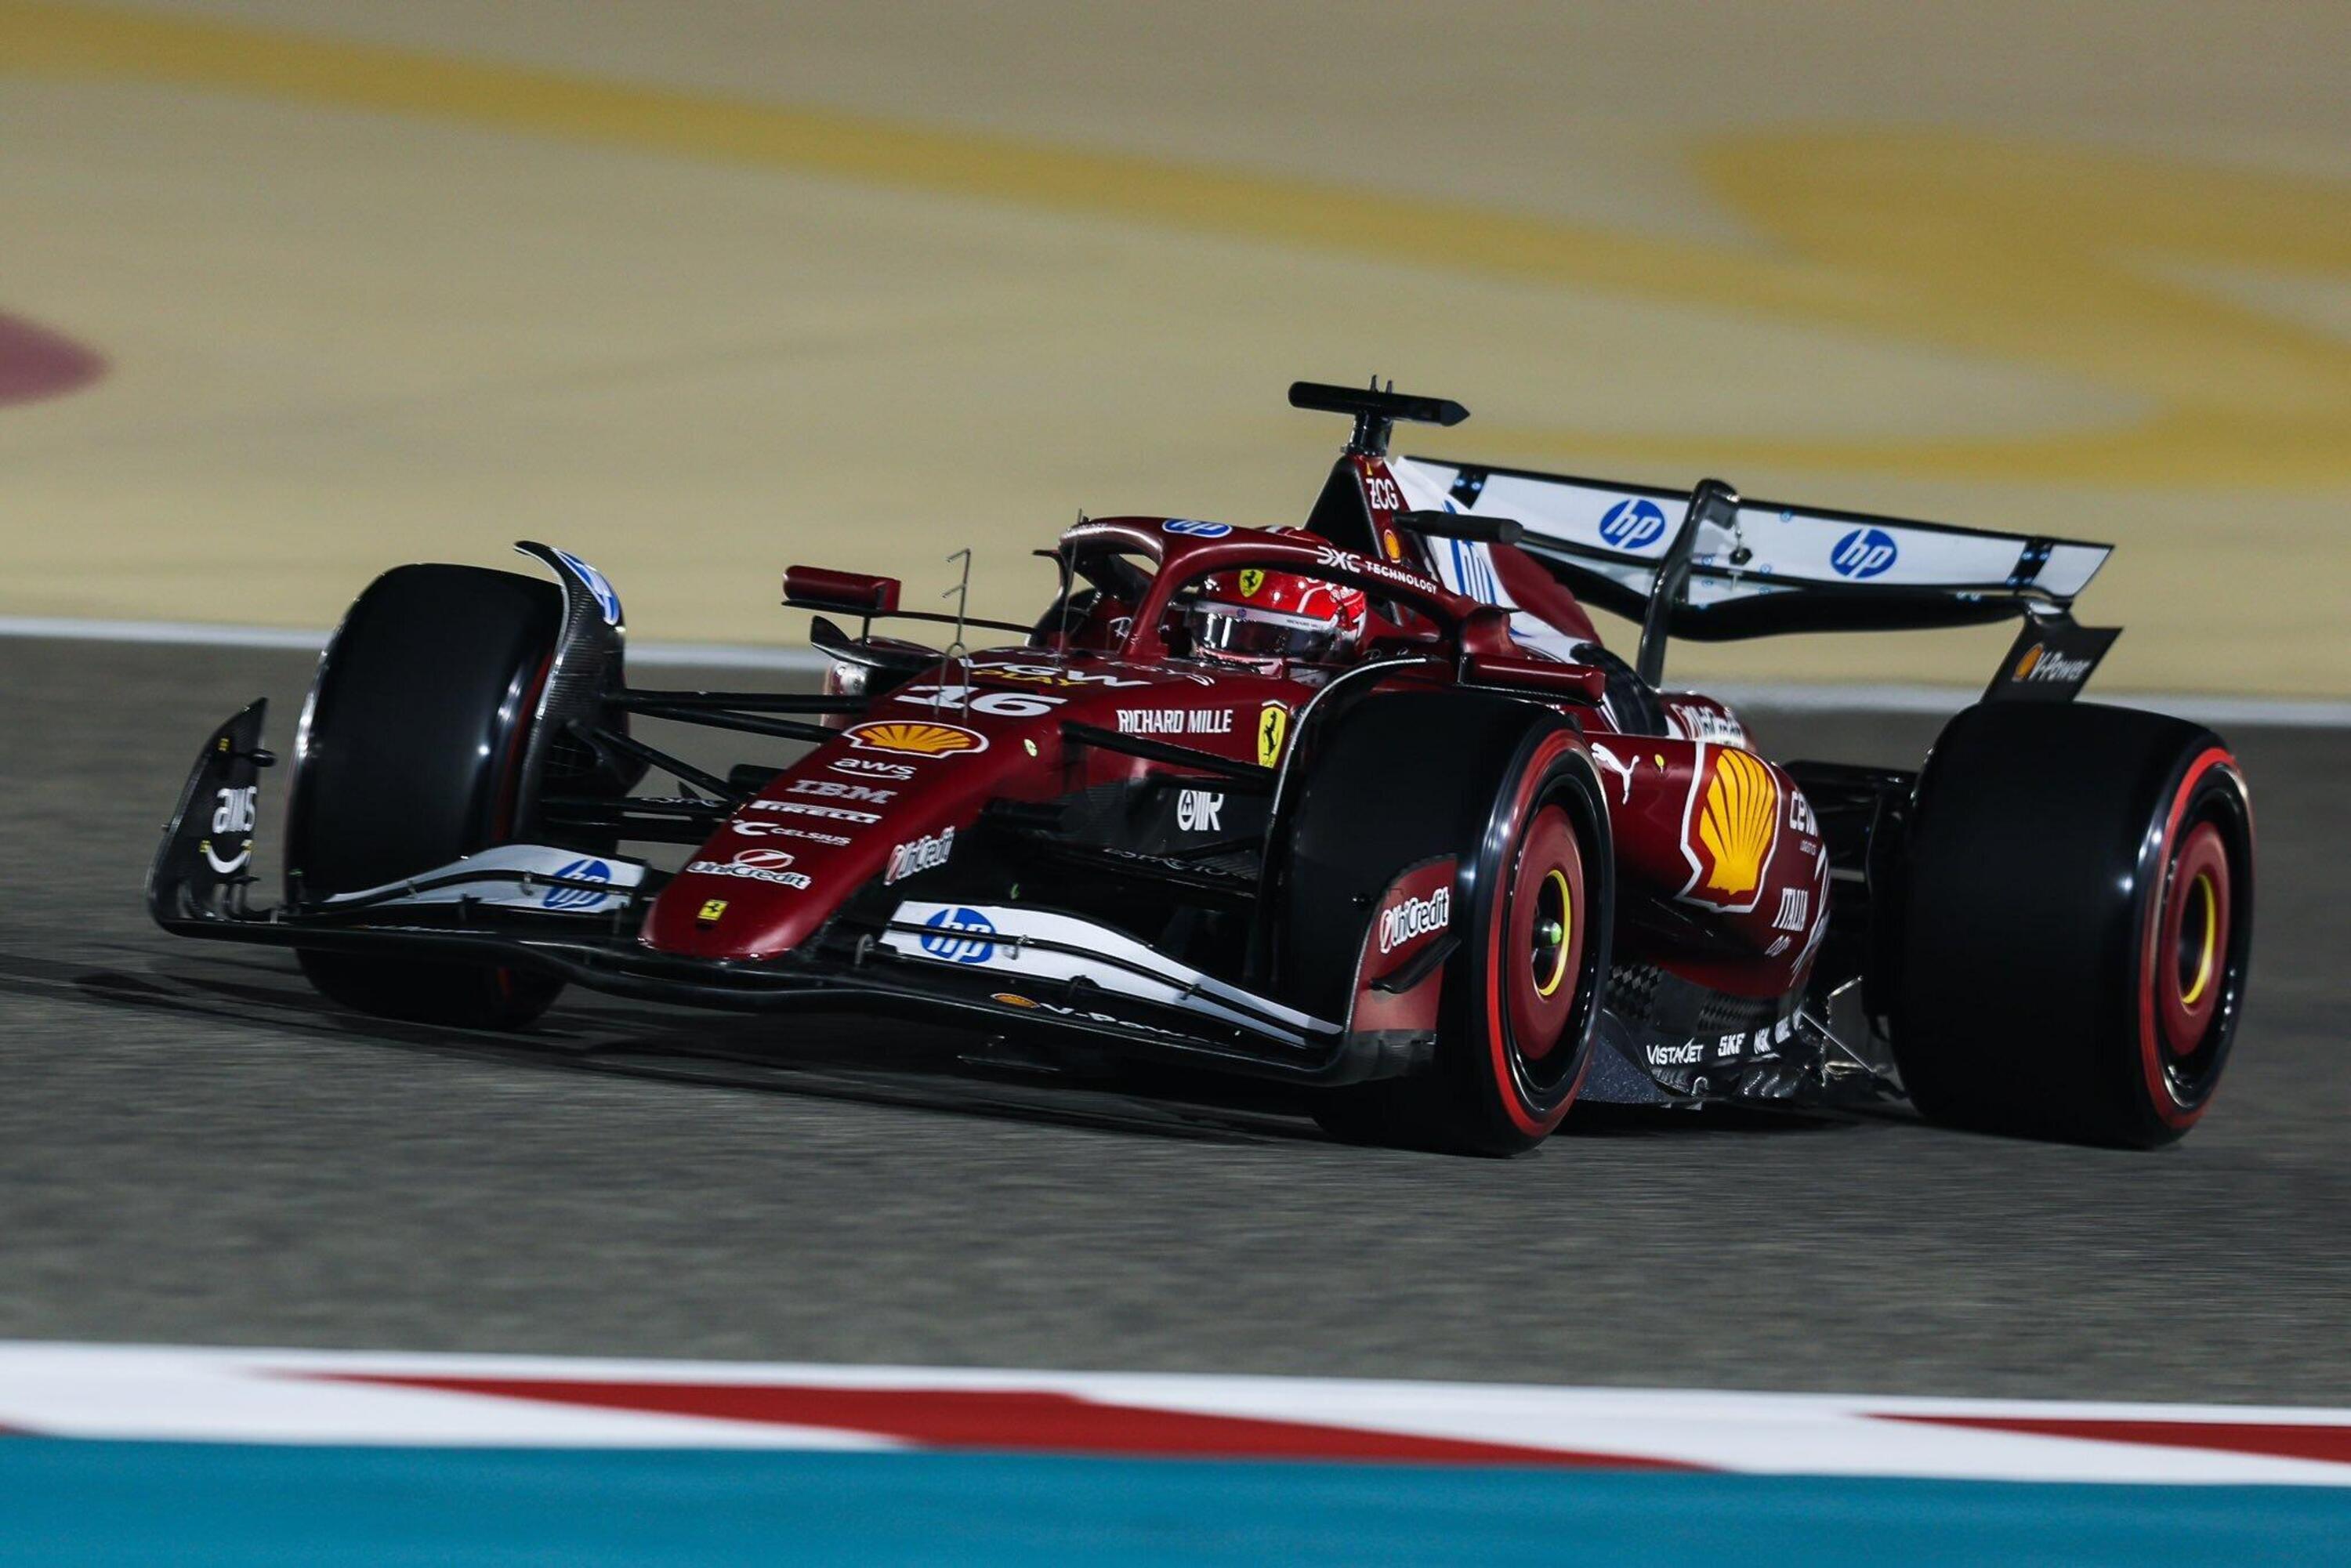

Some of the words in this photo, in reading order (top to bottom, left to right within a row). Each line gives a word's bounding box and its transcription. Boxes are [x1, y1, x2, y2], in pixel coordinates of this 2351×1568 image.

[1604, 499, 1661, 549] hp
[1834, 527, 1893, 578] hp
[1366, 560, 1438, 595] TECHNOLOGY
[971, 668, 1088, 686] PLAY
[893, 686, 1068, 717] 16
[1116, 709, 1184, 733] RICHARD
[1186, 709, 1233, 733] MILLE
[834, 758, 917, 776] aws
[786, 780, 898, 804] IBM
[750, 800, 882, 824] PIRELLI
[770, 827, 853, 845] CELSIUS
[547, 859, 608, 909] hp
[687, 861, 812, 890] UniCredit
[1392, 886, 1449, 946] UniCredit
[928, 907, 992, 962] hp
[1718, 1033, 1745, 1056] SKF
